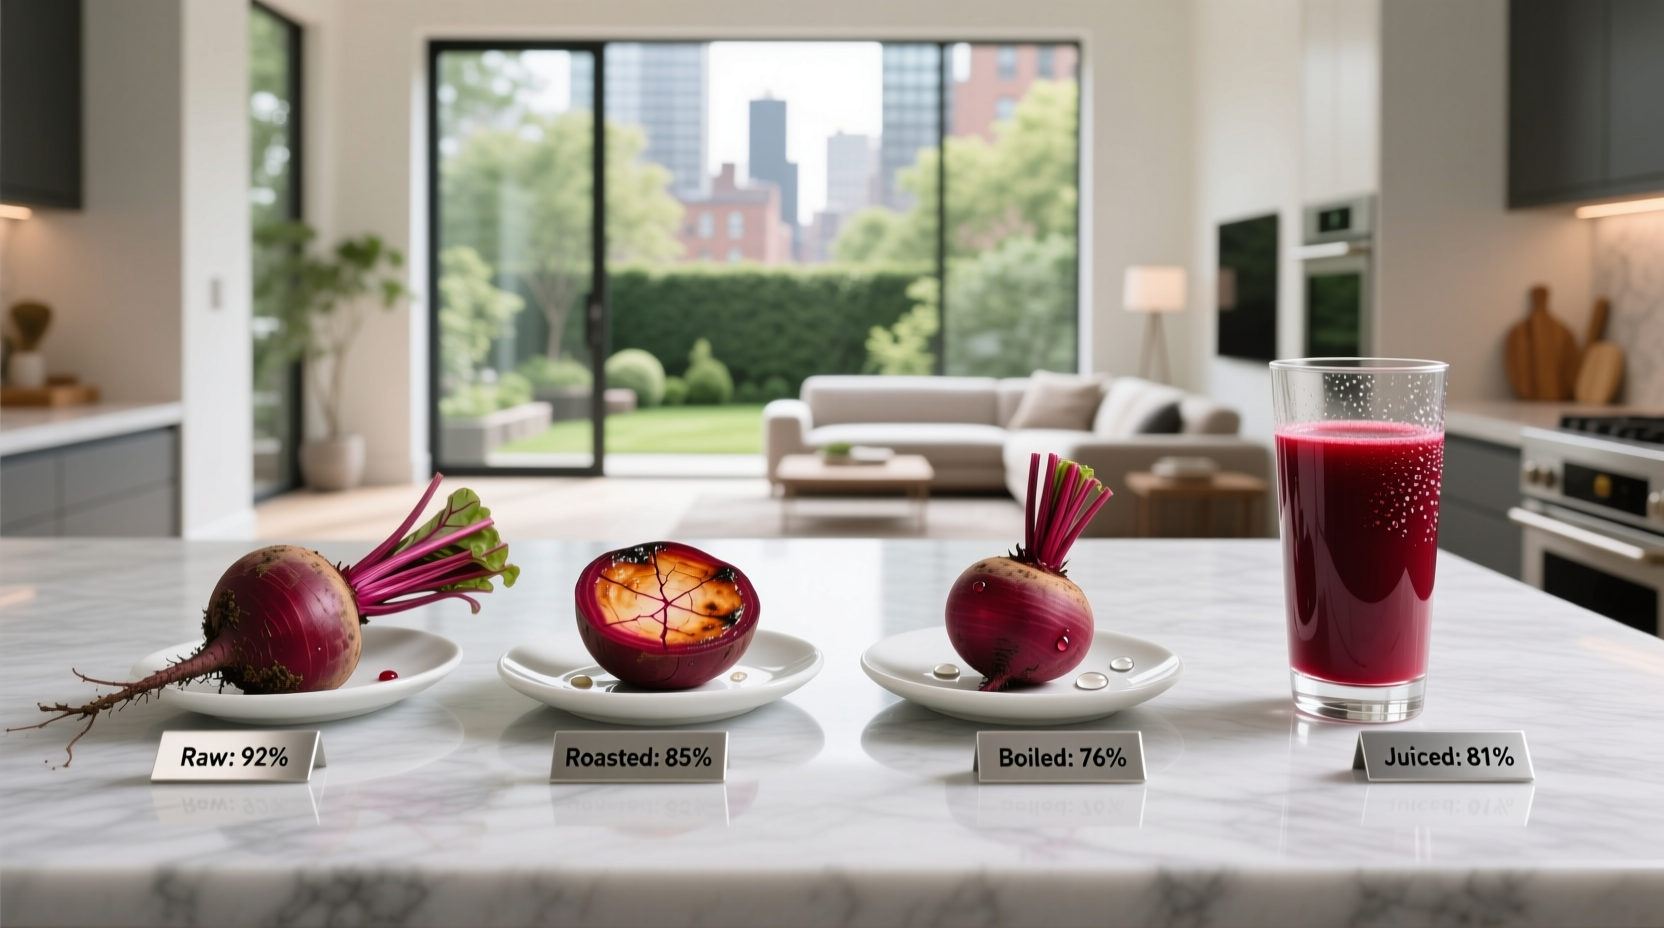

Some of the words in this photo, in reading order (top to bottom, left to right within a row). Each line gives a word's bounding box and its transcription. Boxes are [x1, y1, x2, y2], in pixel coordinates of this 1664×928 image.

[180, 747, 235, 767] Raw:
[241, 747, 289, 767] 92%
[565, 747, 660, 768] Roasted:
[664, 747, 713, 768] 85%
[999, 747, 1074, 768] Boiled:
[1079, 747, 1127, 768] 76%
[1384, 745, 1462, 767] Juiced:
[1466, 746, 1515, 767] 81%
